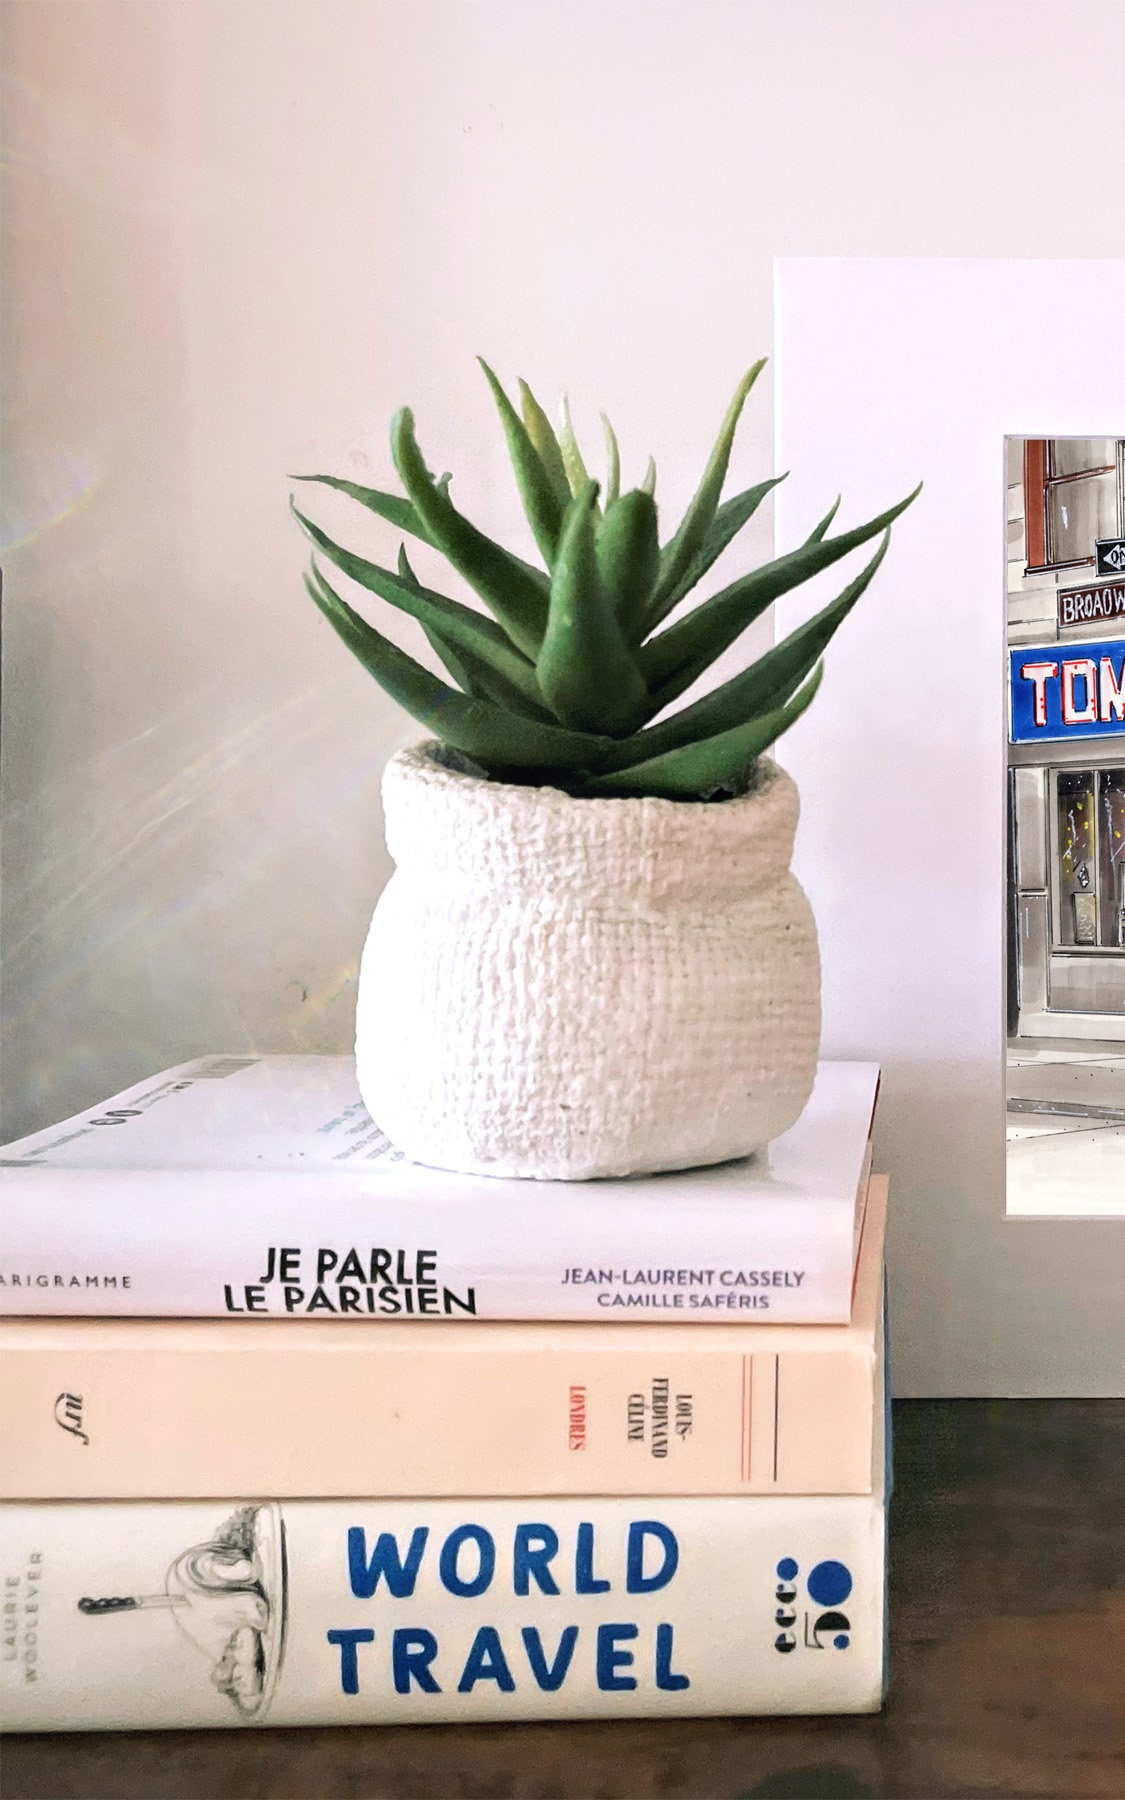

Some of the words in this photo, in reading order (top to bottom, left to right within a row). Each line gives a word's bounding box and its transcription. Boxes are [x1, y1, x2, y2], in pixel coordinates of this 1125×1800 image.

[224, 1284, 268, 1313] LE
[284, 1284, 476, 1315] PARISIEN
[260, 1247, 301, 1284] JE
[318, 1248, 437, 1286] PARLE
[561, 1268, 716, 1287] JEAN-LAURENT
[718, 1270, 806, 1288] CASSELY
[596, 1292, 684, 1309] CAMILLE
[688, 1289, 770, 1309] SAFÉRIS
[568, 1385, 587, 1451] LONDRES
[651, 1377, 669, 1459] FERDINAND
[347, 1520, 679, 1599] WORLD
[4, 1576, 20, 1661] LAURIE
[24, 1552, 42, 1683] WOOLEVER
[326, 1623, 691, 1696] TRAVEL
